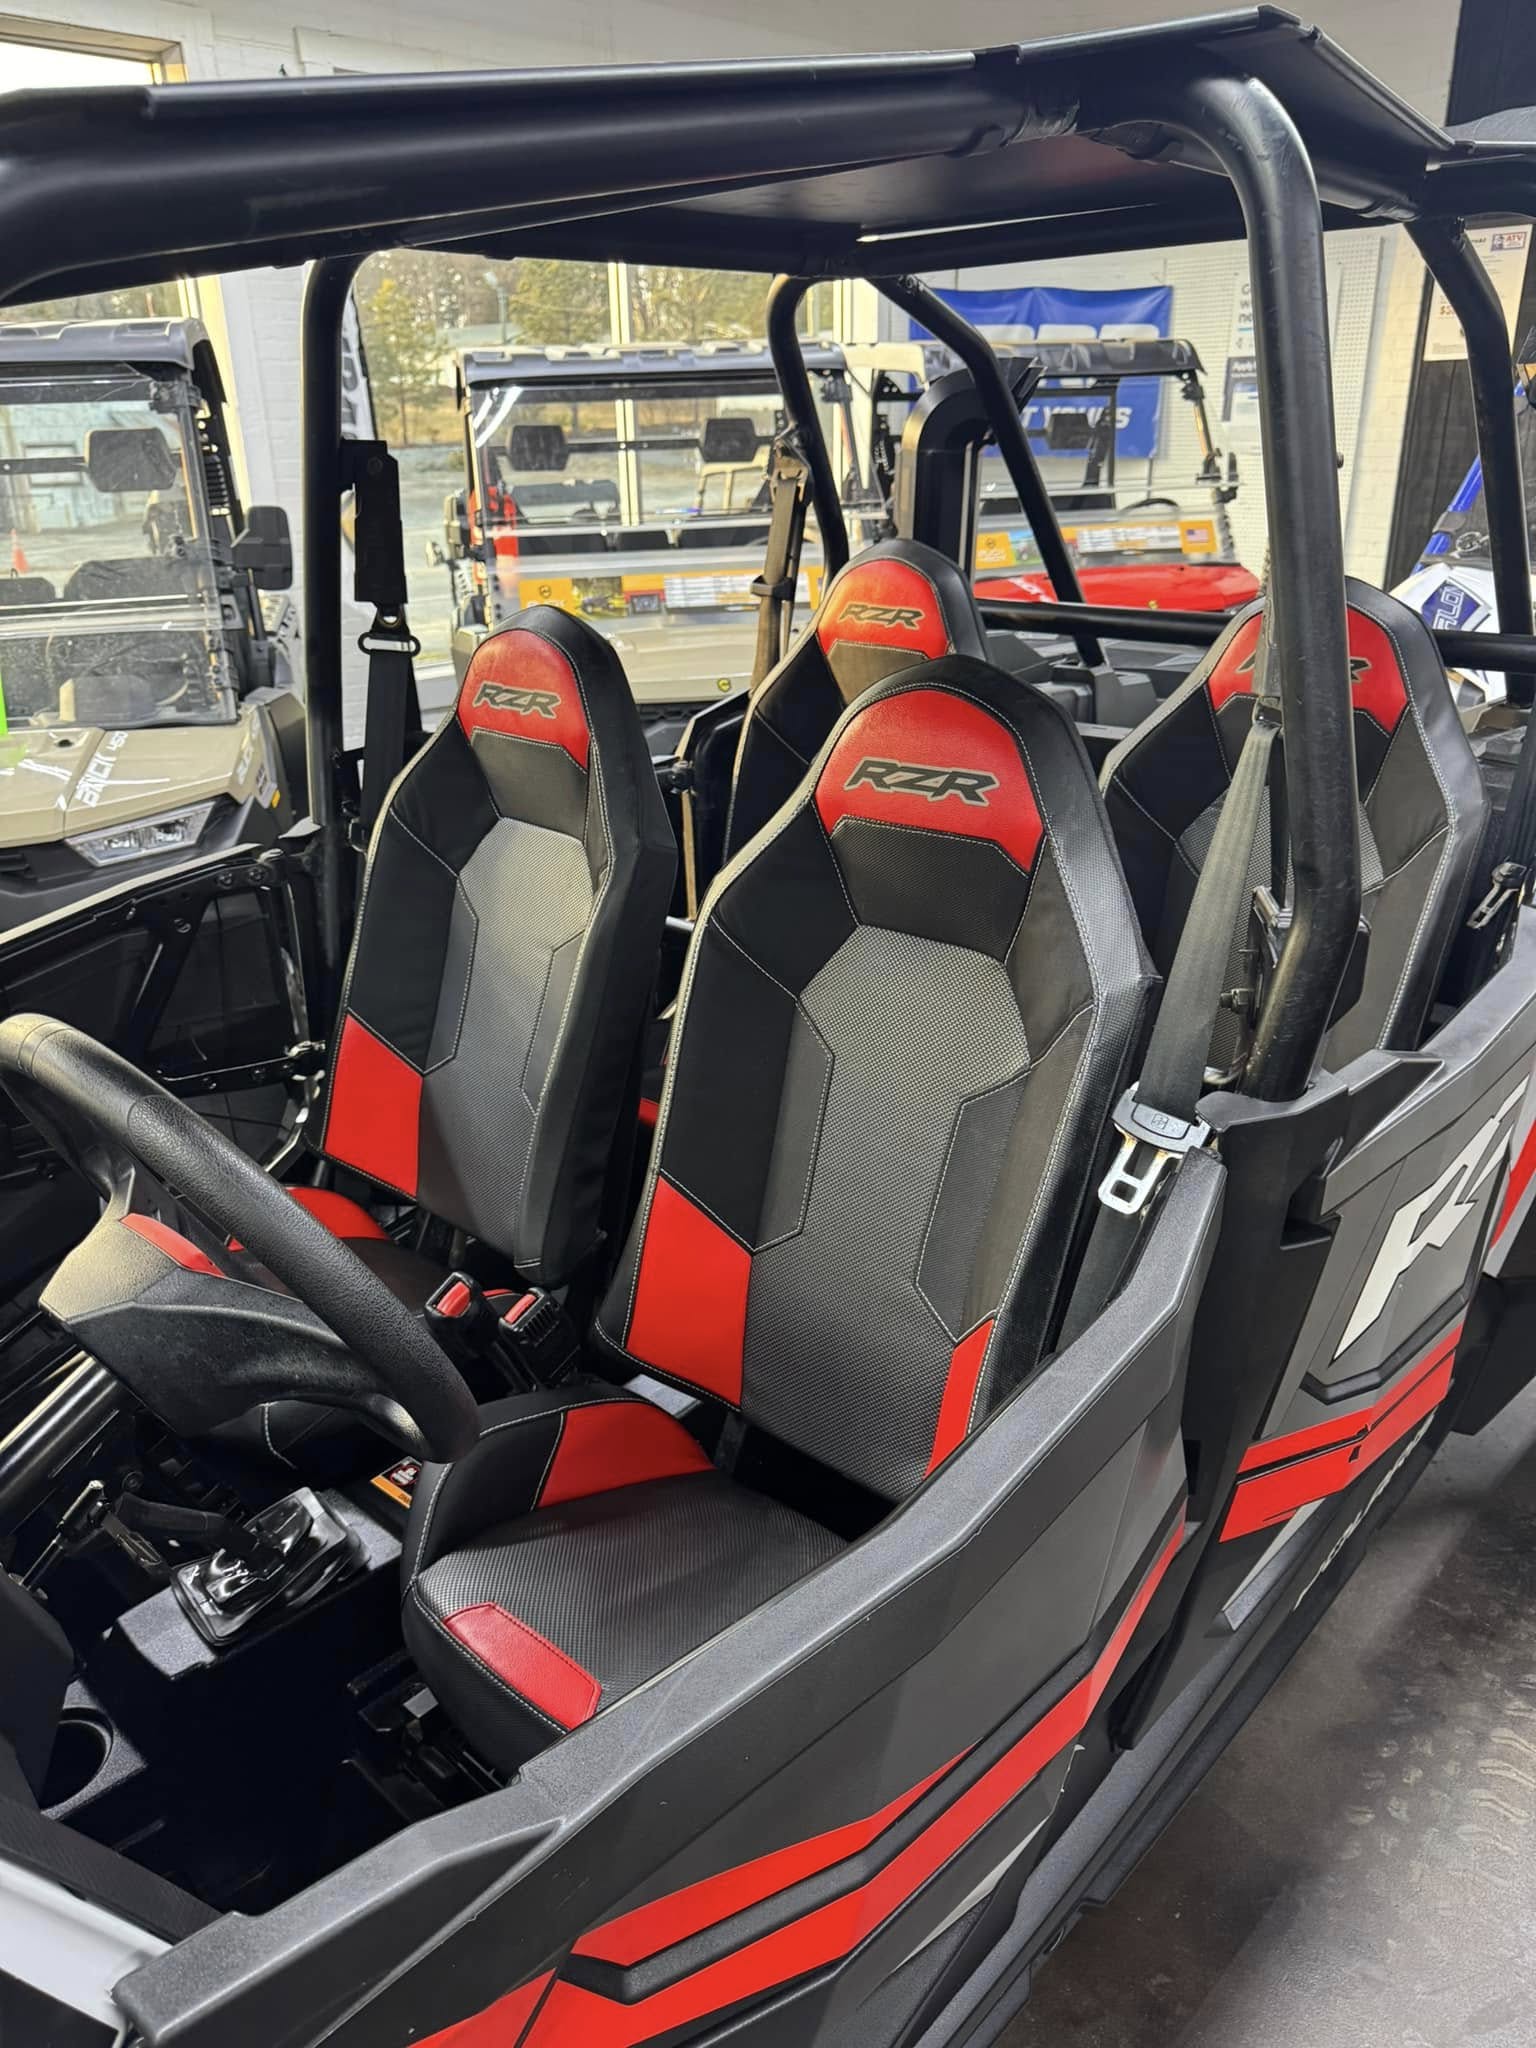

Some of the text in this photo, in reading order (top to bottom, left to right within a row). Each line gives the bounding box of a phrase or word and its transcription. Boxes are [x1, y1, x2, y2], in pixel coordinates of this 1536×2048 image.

[839, 603, 925, 630] RZR
[472, 680, 562, 719] RZR
[844, 755, 1000, 807] RZR
